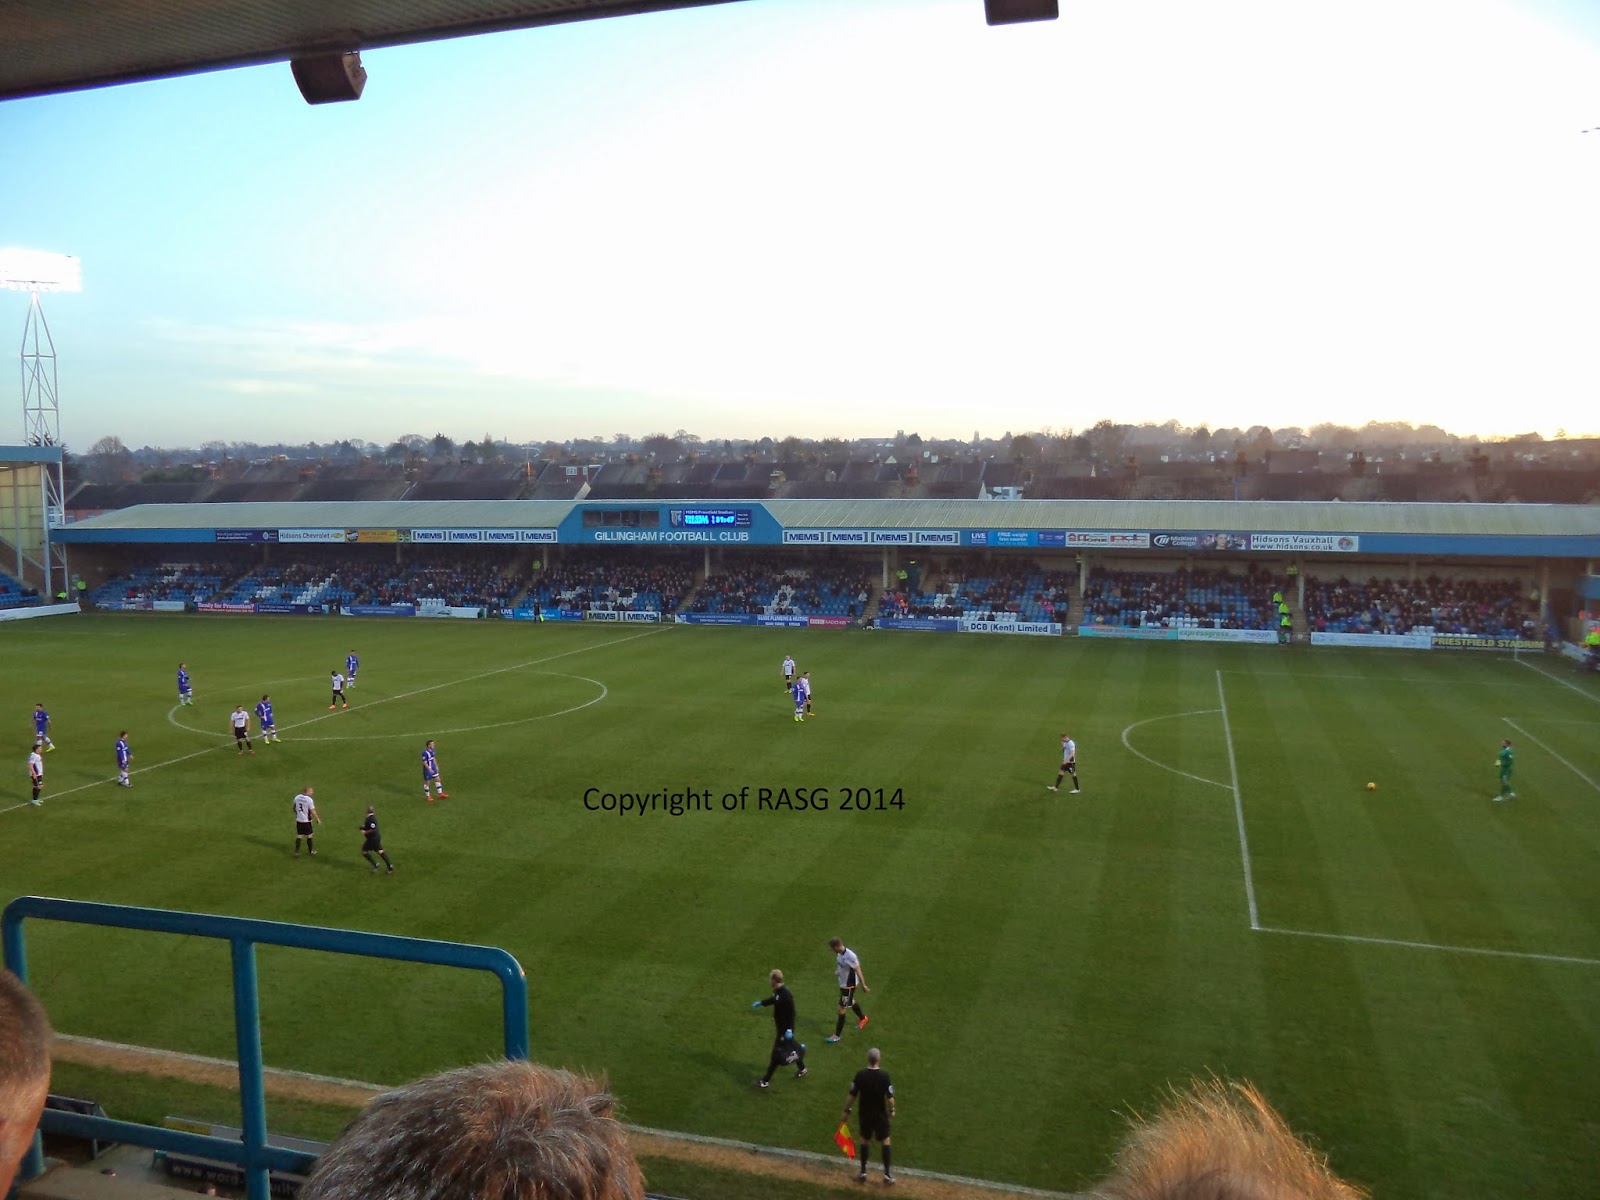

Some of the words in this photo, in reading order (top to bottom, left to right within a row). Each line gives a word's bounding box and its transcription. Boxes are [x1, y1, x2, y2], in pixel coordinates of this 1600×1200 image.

[280, 532, 302, 540] Hidsons
[302, 532, 330, 540] Chevrolet
[417, 532, 443, 540] MEMS
[452, 532, 478, 540] MEMS
[594, 531, 657, 541] GILLINGHAM
[659, 531, 717, 541] FOOTBALL
[719, 531, 749, 541] CLUB
[789, 533, 820, 541] MEMS
[832, 533, 863, 541] MEMS
[876, 534, 908, 542] MEMS
[920, 534, 953, 542] MEMS
[1252, 535, 1290, 543] Hidsons
[1292, 535, 1333, 544] Vauxhall
[1252, 543, 1333, 551] www.hidsons.co.uk
[627, 613, 654, 621] MEMS
[970, 623, 988, 631] DCB
[990, 624, 1015, 633] (Kent)
[1017, 624, 1048, 633] Limited
[1432, 637, 1495, 648] PRIESTFIELD
[1498, 638, 1545, 649] STADIUM
